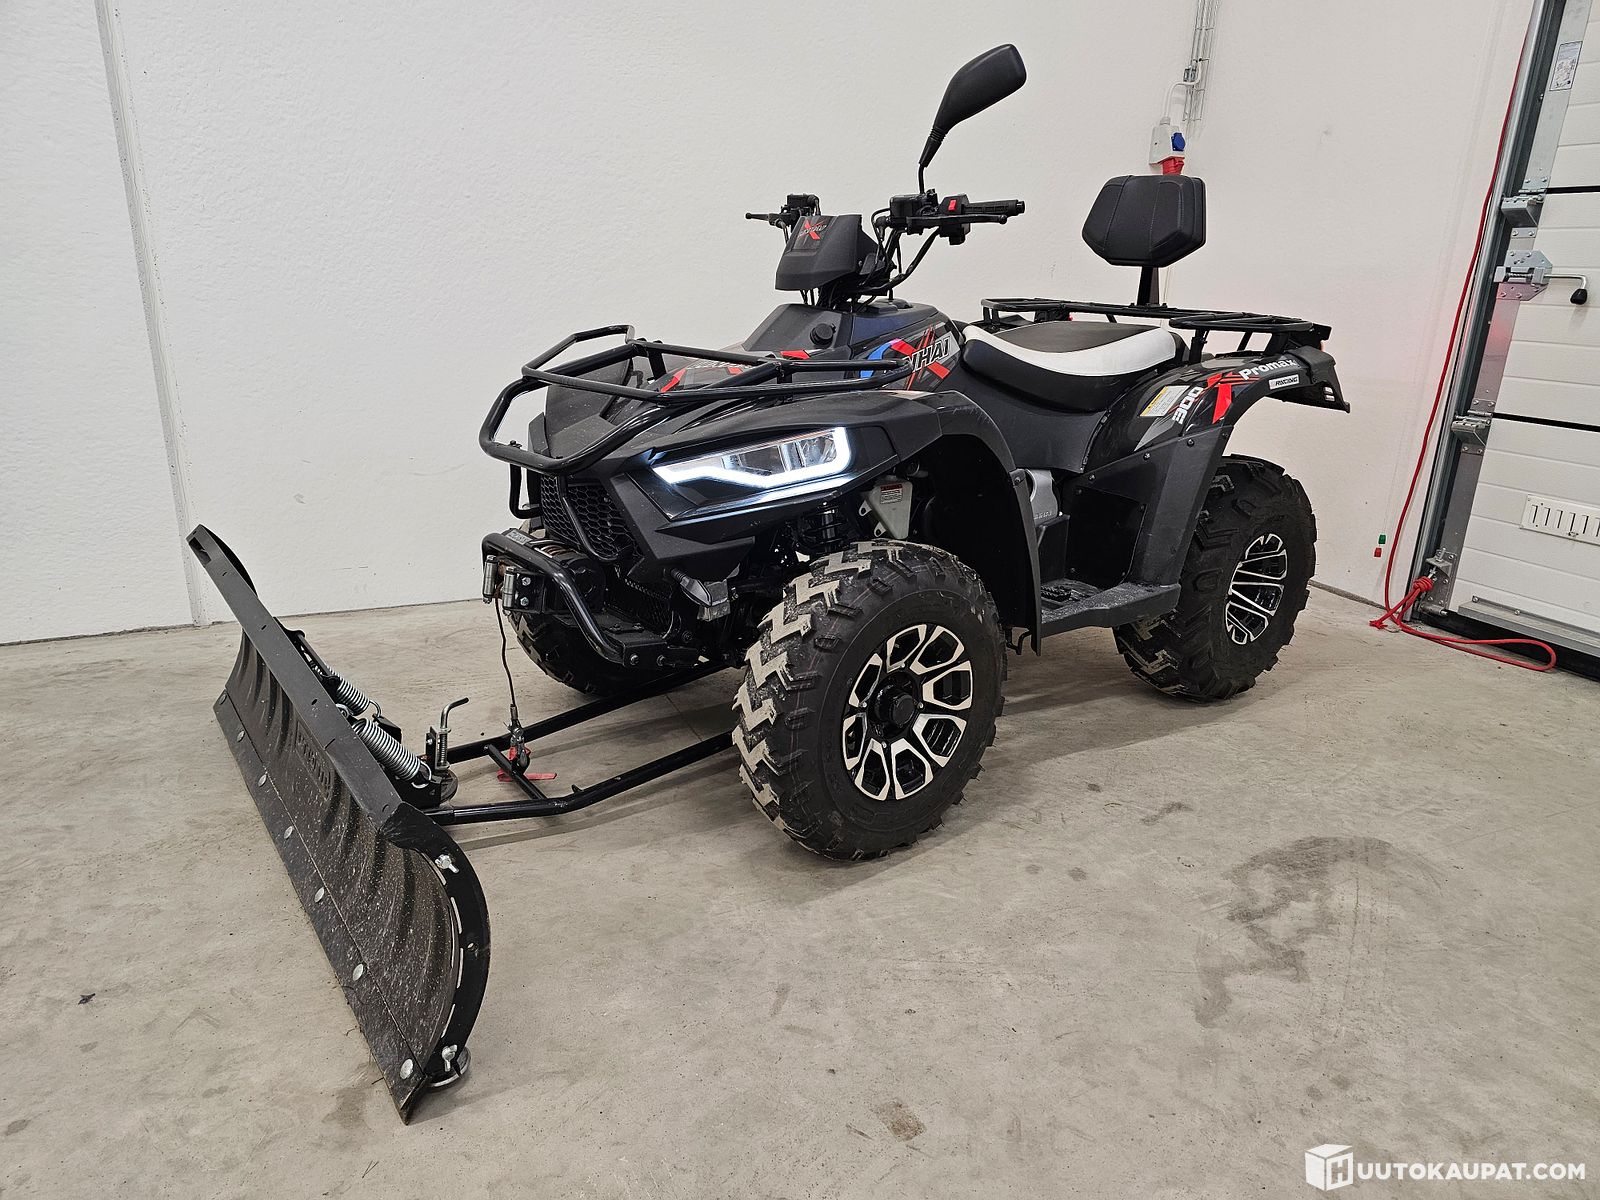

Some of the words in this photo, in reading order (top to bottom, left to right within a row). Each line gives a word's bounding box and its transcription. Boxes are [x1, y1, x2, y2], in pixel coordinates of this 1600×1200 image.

[901, 335, 953, 373] NHAI
[1238, 359, 1298, 381] Promax
[1171, 386, 1204, 425] 300
